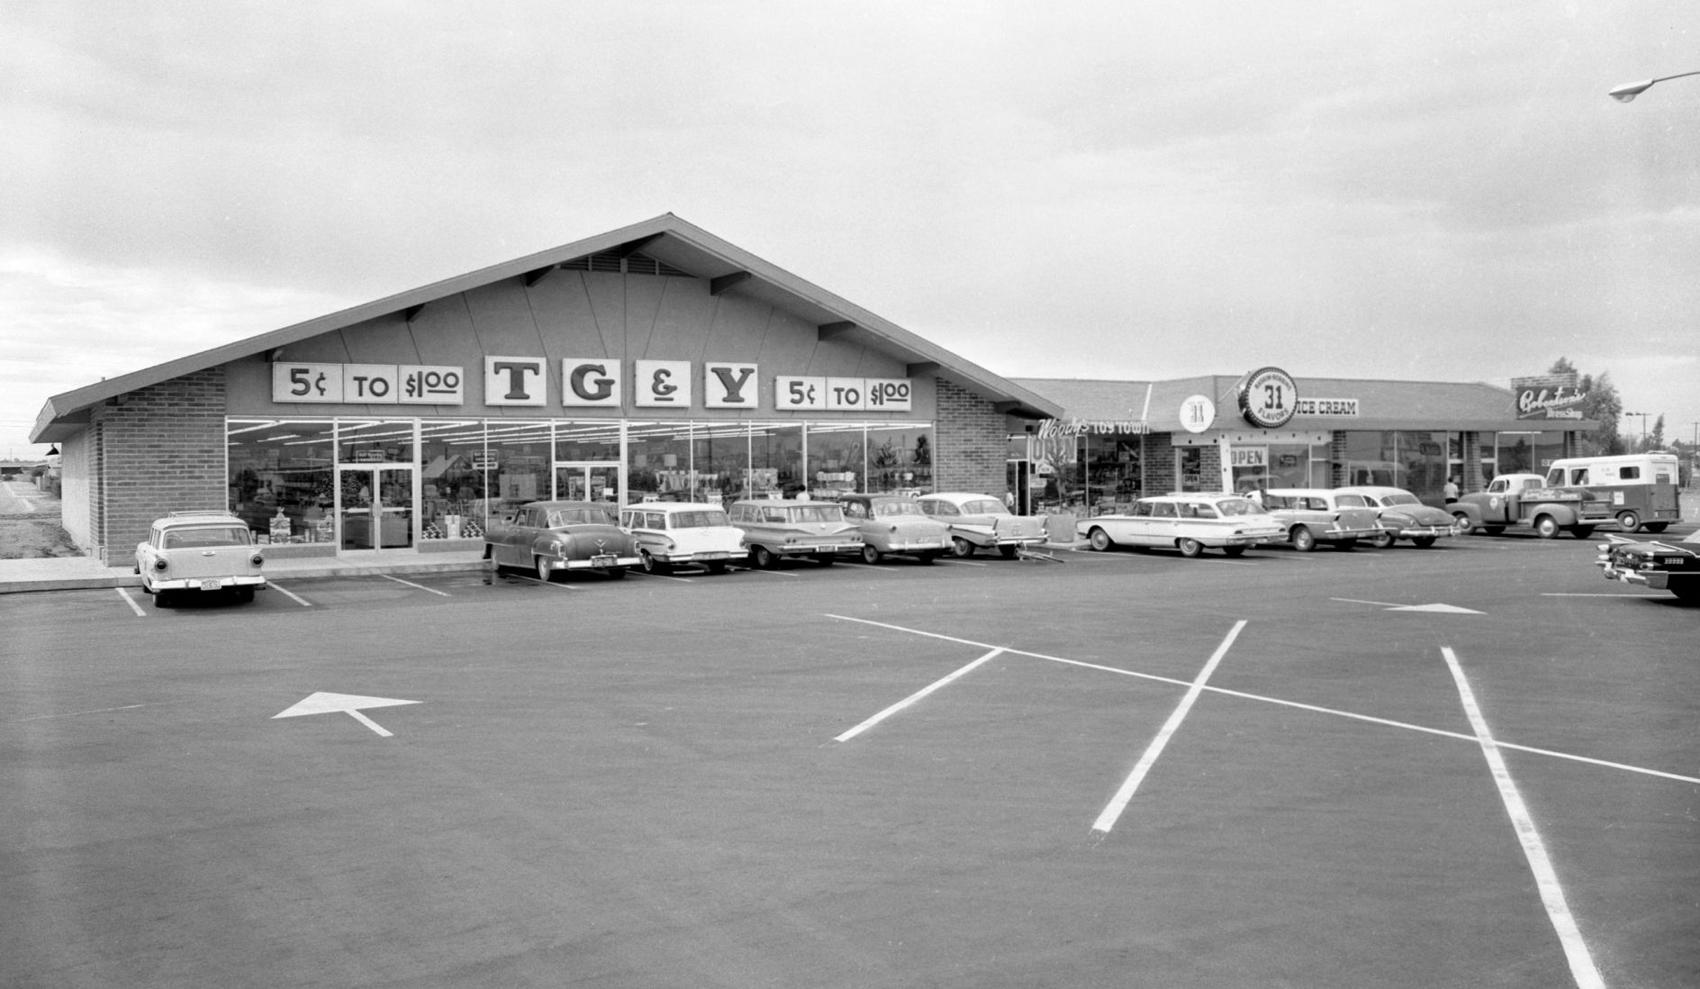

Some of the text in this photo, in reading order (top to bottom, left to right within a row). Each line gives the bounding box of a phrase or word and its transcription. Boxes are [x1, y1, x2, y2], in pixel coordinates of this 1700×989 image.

[290, 368, 327, 396] 5¢
[353, 376, 390, 397] TO
[494, 361, 755, 403] T G & Y
[789, 381, 816, 405] 5¢
[833, 387, 860, 405] TO
[1264, 385, 1283, 409] 31
[1297, 401, 1356, 415] ICE CREAM
[1258, 407, 1289, 421] FLAVORS
[1231, 450, 1264, 465] OPEN
